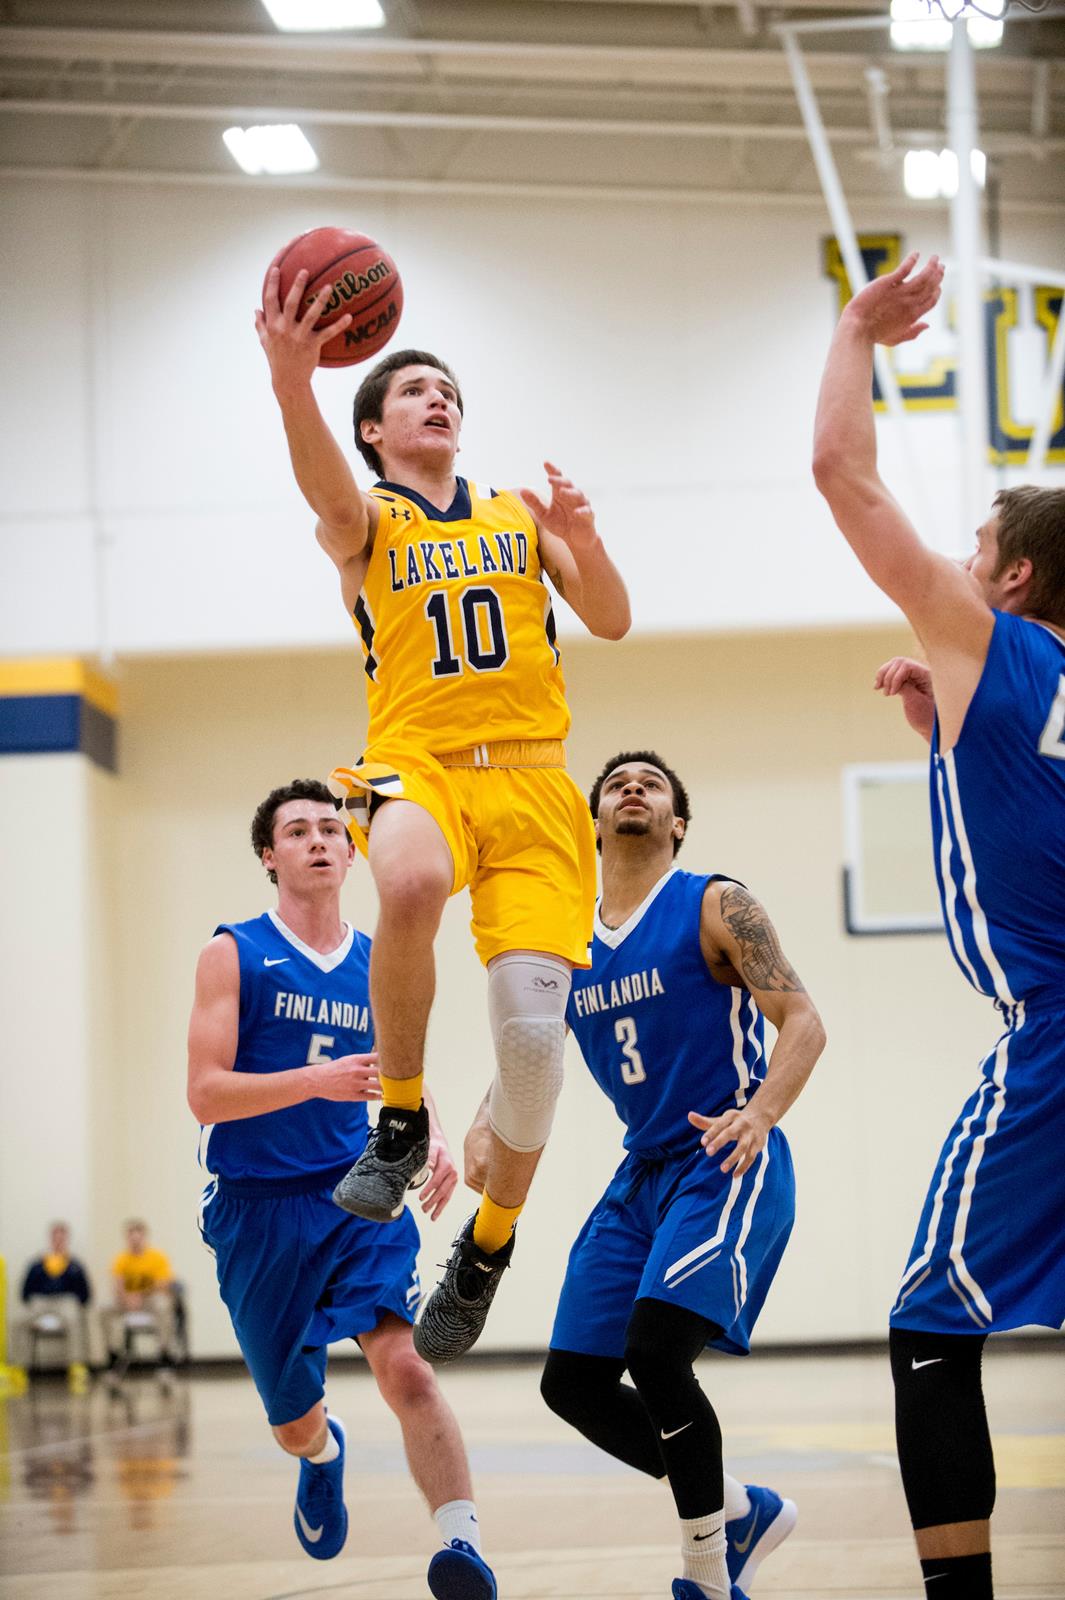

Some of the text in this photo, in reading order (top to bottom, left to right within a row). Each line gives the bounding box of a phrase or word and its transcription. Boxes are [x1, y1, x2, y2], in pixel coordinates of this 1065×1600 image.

[343, 301, 397, 347] NCAA
[388, 532, 528, 592] LAKELAND
[424, 585, 511, 679] 10
[274, 991, 369, 1032] FINLANDIA
[573, 968, 665, 1017] FINLANDIA
[614, 1016, 647, 1085] 3
